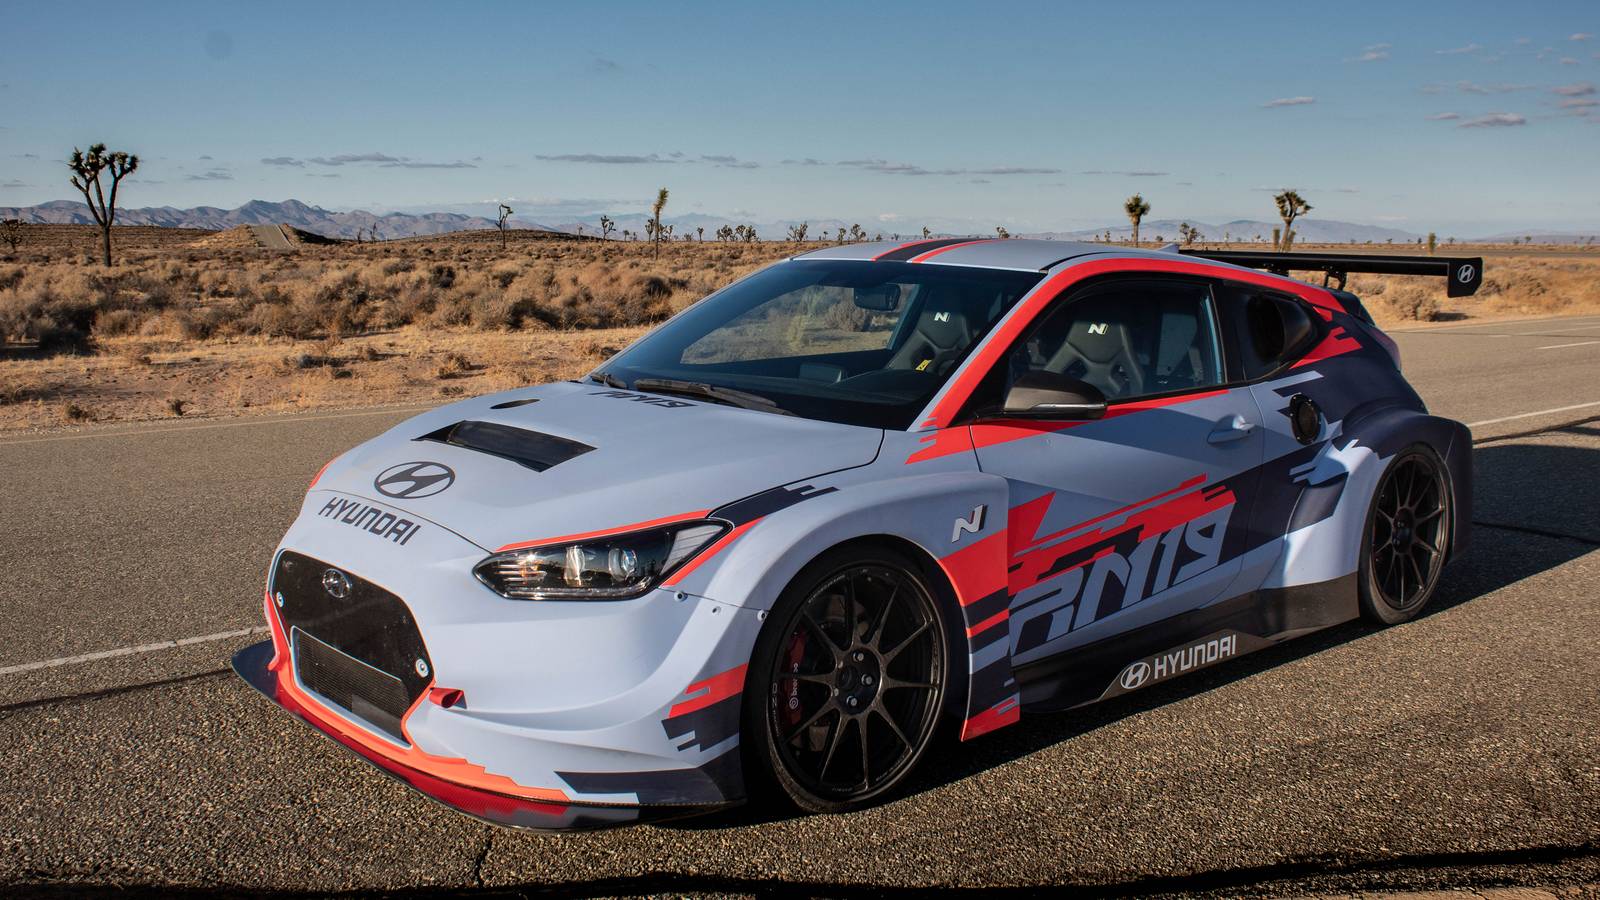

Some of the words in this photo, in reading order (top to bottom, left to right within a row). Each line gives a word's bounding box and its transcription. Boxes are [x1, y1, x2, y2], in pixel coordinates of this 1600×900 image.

[934, 312, 950, 323] N
[1088, 323, 1108, 336] N
[318, 497, 422, 546] HYUNDAI
[951, 504, 988, 544] N
[1009, 501, 1237, 657] RN19
[1154, 635, 1237, 680] HYUNDAI
